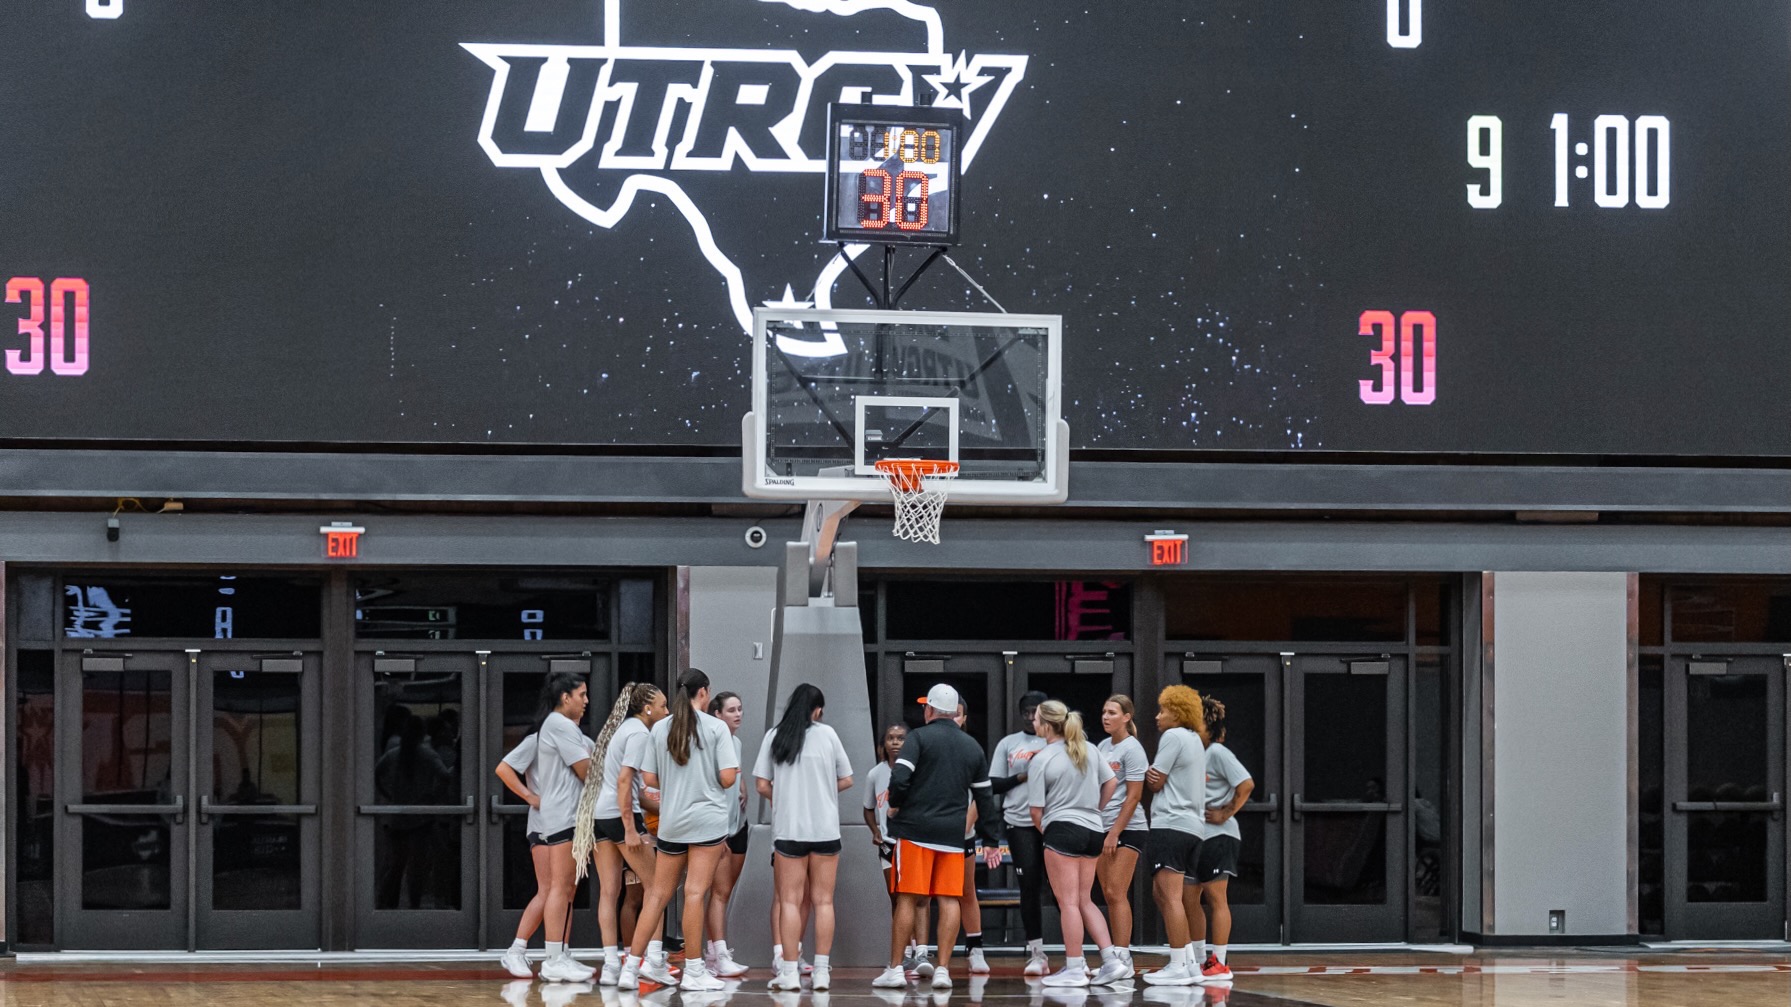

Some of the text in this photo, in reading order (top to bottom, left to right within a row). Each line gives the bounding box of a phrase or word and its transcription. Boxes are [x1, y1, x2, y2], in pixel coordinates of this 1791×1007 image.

[1466, 113, 1670, 209] 9 1:00
[860, 168, 929, 230] 30
[4, 276, 90, 375] 30
[1358, 310, 1436, 405] 30
[765, 478, 794, 486] SPALDING
[327, 532, 359, 557] EXIT
[1153, 540, 1183, 565] EXIT
